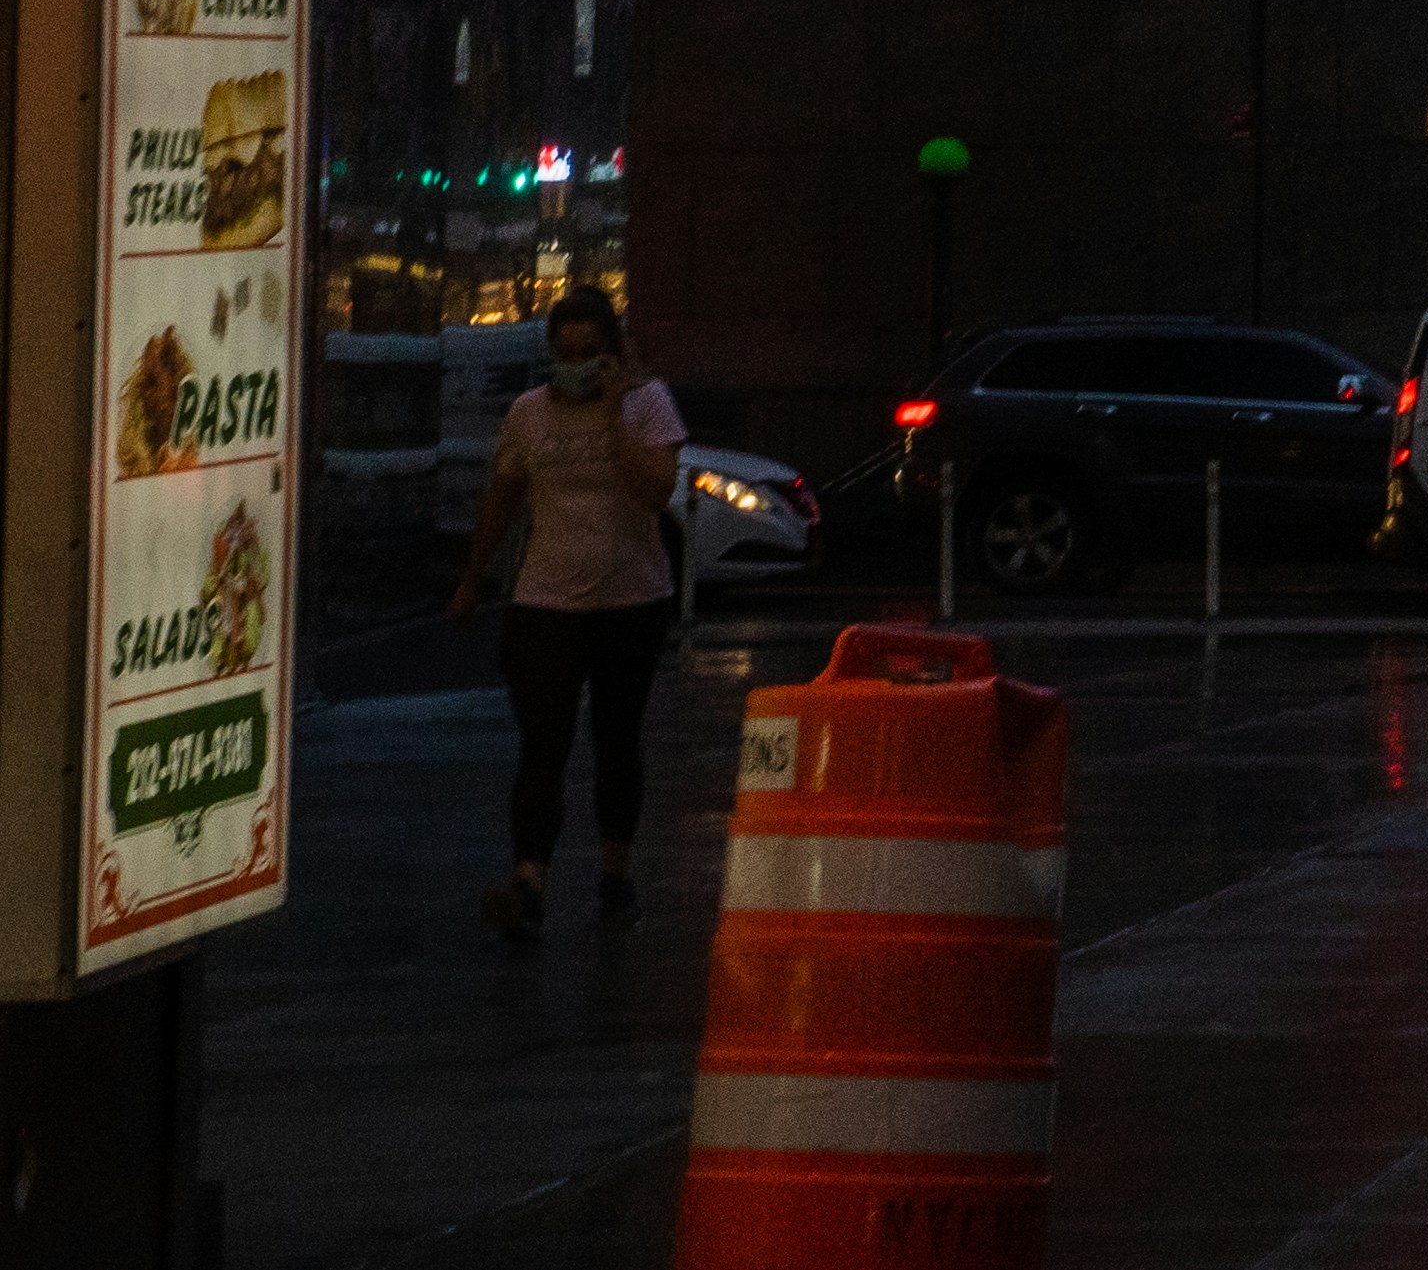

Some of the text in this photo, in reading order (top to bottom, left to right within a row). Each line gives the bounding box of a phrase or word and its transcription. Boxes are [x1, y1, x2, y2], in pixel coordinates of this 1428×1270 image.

[126, 128, 201, 171] PHILLY
[123, 179, 209, 228] STEAKS
[172, 366, 280, 449] PASTA
[111, 603, 222, 679] SALADS
